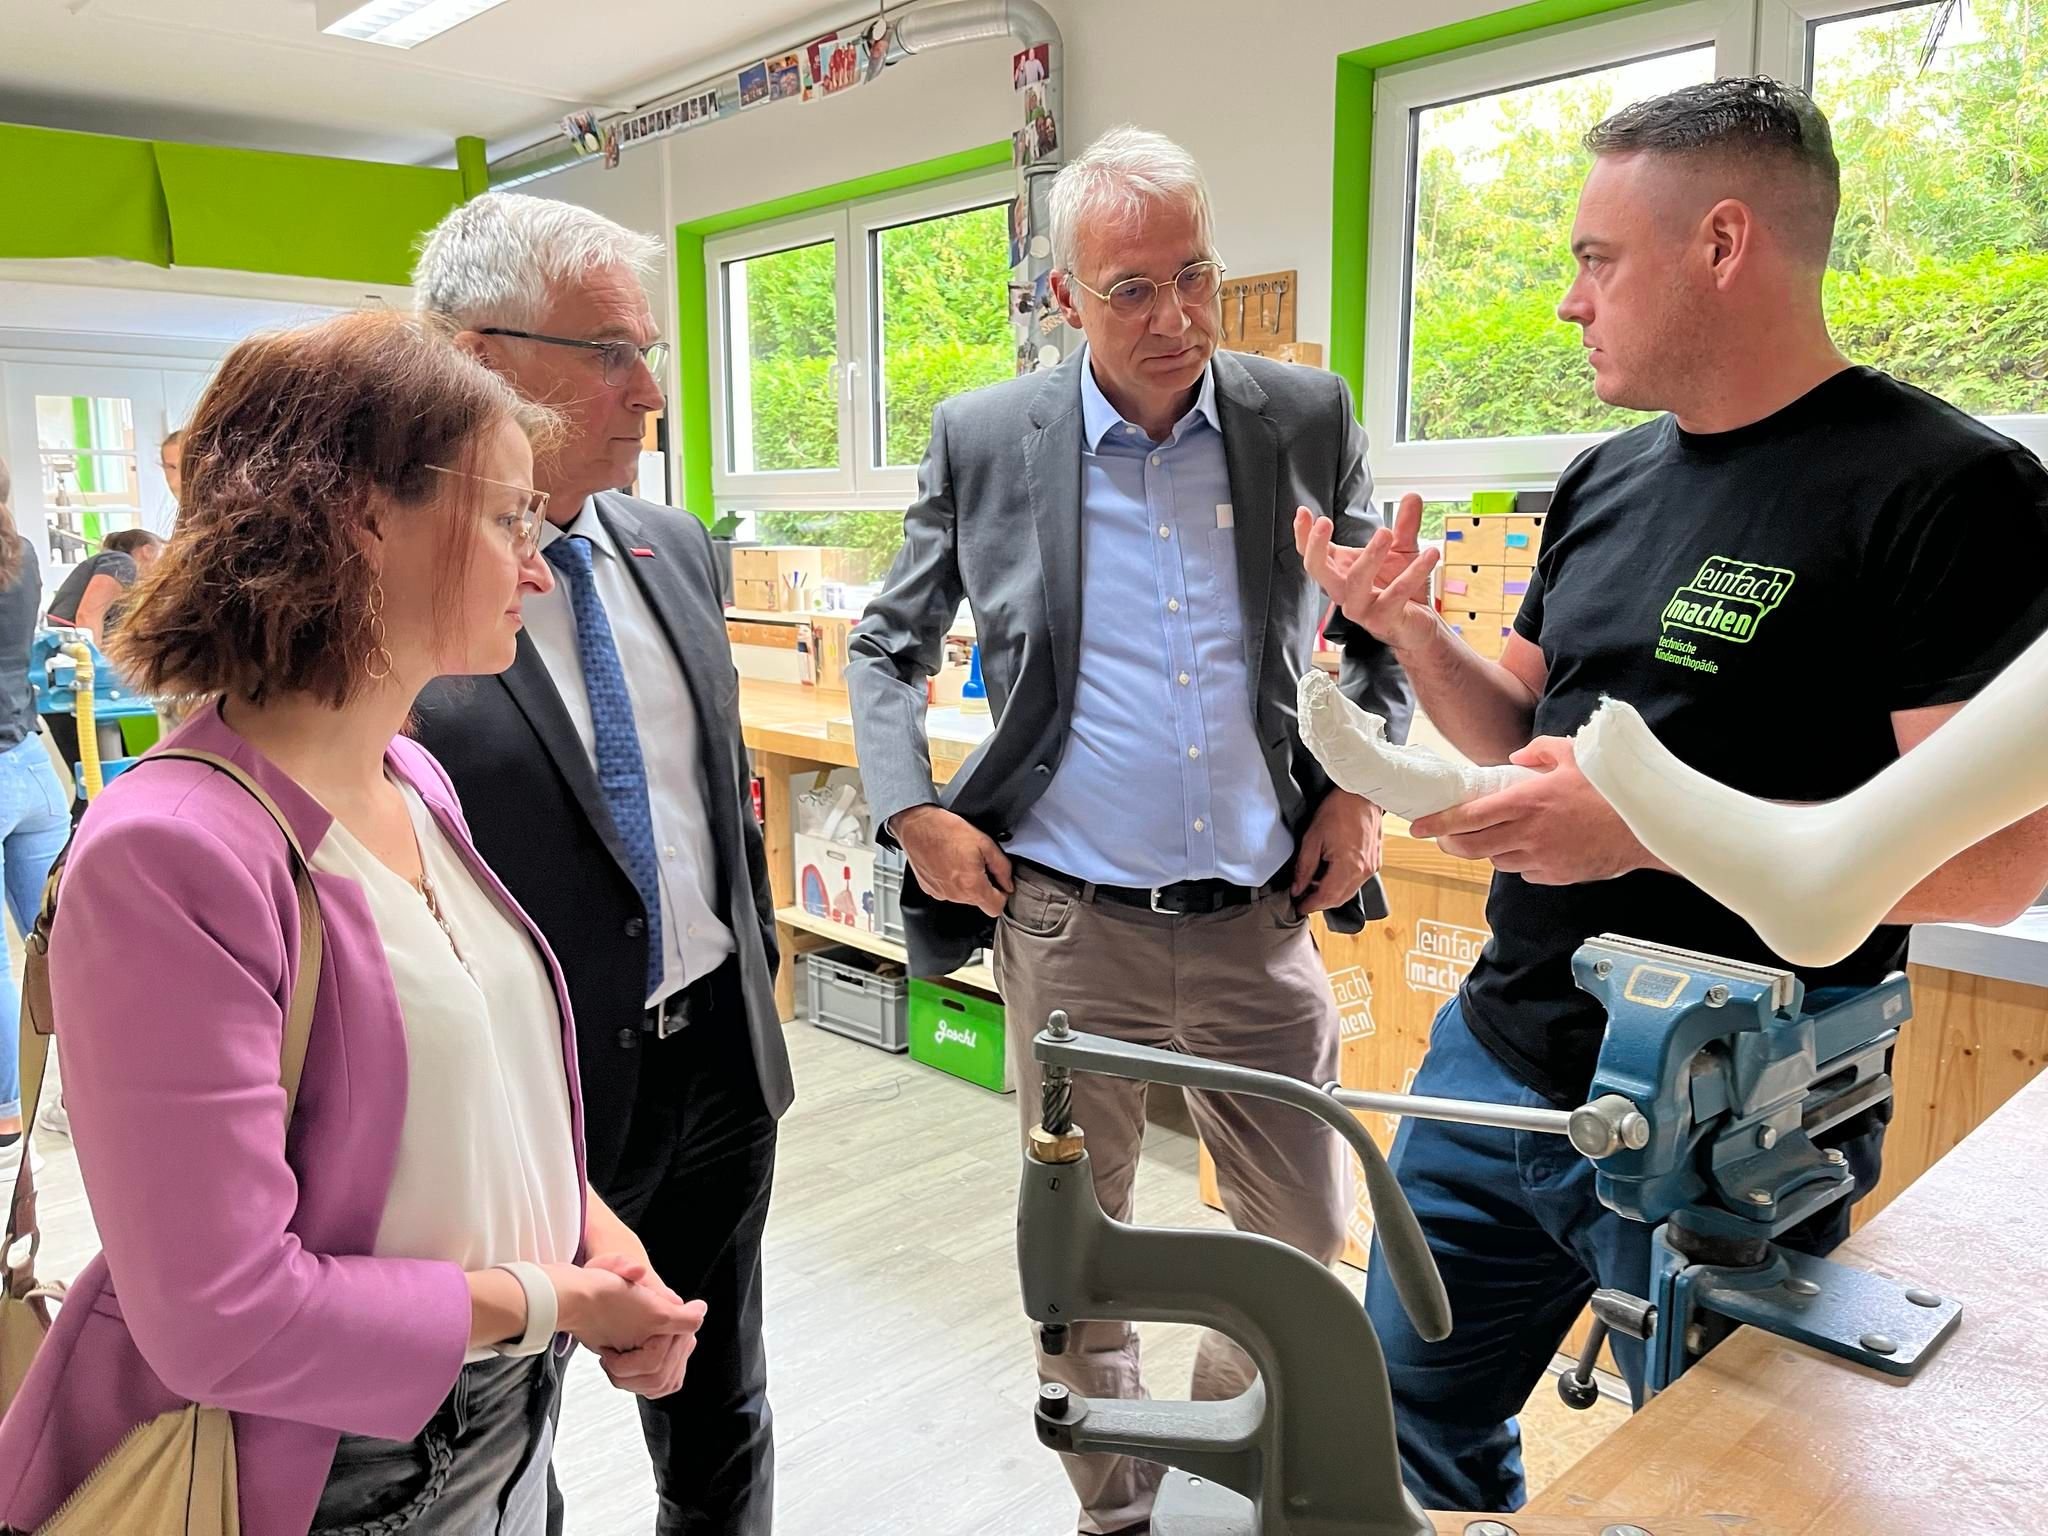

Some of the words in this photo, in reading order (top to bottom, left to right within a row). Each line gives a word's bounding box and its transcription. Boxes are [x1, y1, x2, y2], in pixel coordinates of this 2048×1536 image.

[1697, 564, 1784, 601] einfach
[1667, 598, 1752, 636] machen
[1655, 647, 1719, 674] Kinderorthopädie
[1658, 635, 1697, 655] technische
[1420, 926, 1489, 961] einfac
[1327, 971, 1369, 1004] fach
[1410, 961, 1465, 990] mach
